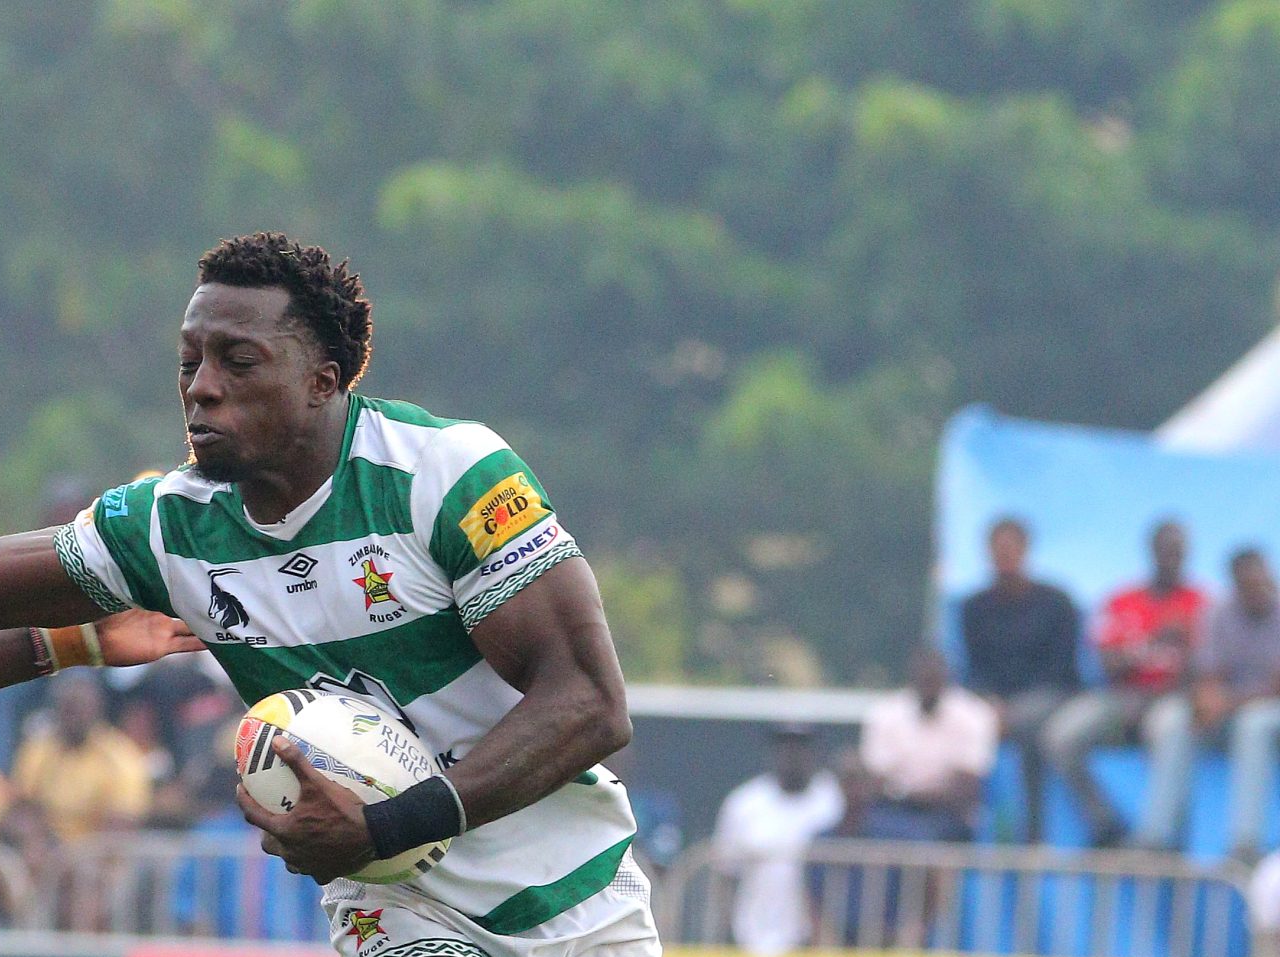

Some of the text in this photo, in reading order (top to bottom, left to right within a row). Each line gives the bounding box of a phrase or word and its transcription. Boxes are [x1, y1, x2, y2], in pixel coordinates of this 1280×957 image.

[480, 487, 517, 519] SHUMBA
[484, 495, 529, 535] GOLD
[480, 527, 555, 576] ECONET
[369, 605, 408, 623] RUGBY
[377, 739, 424, 782] AFRIC
